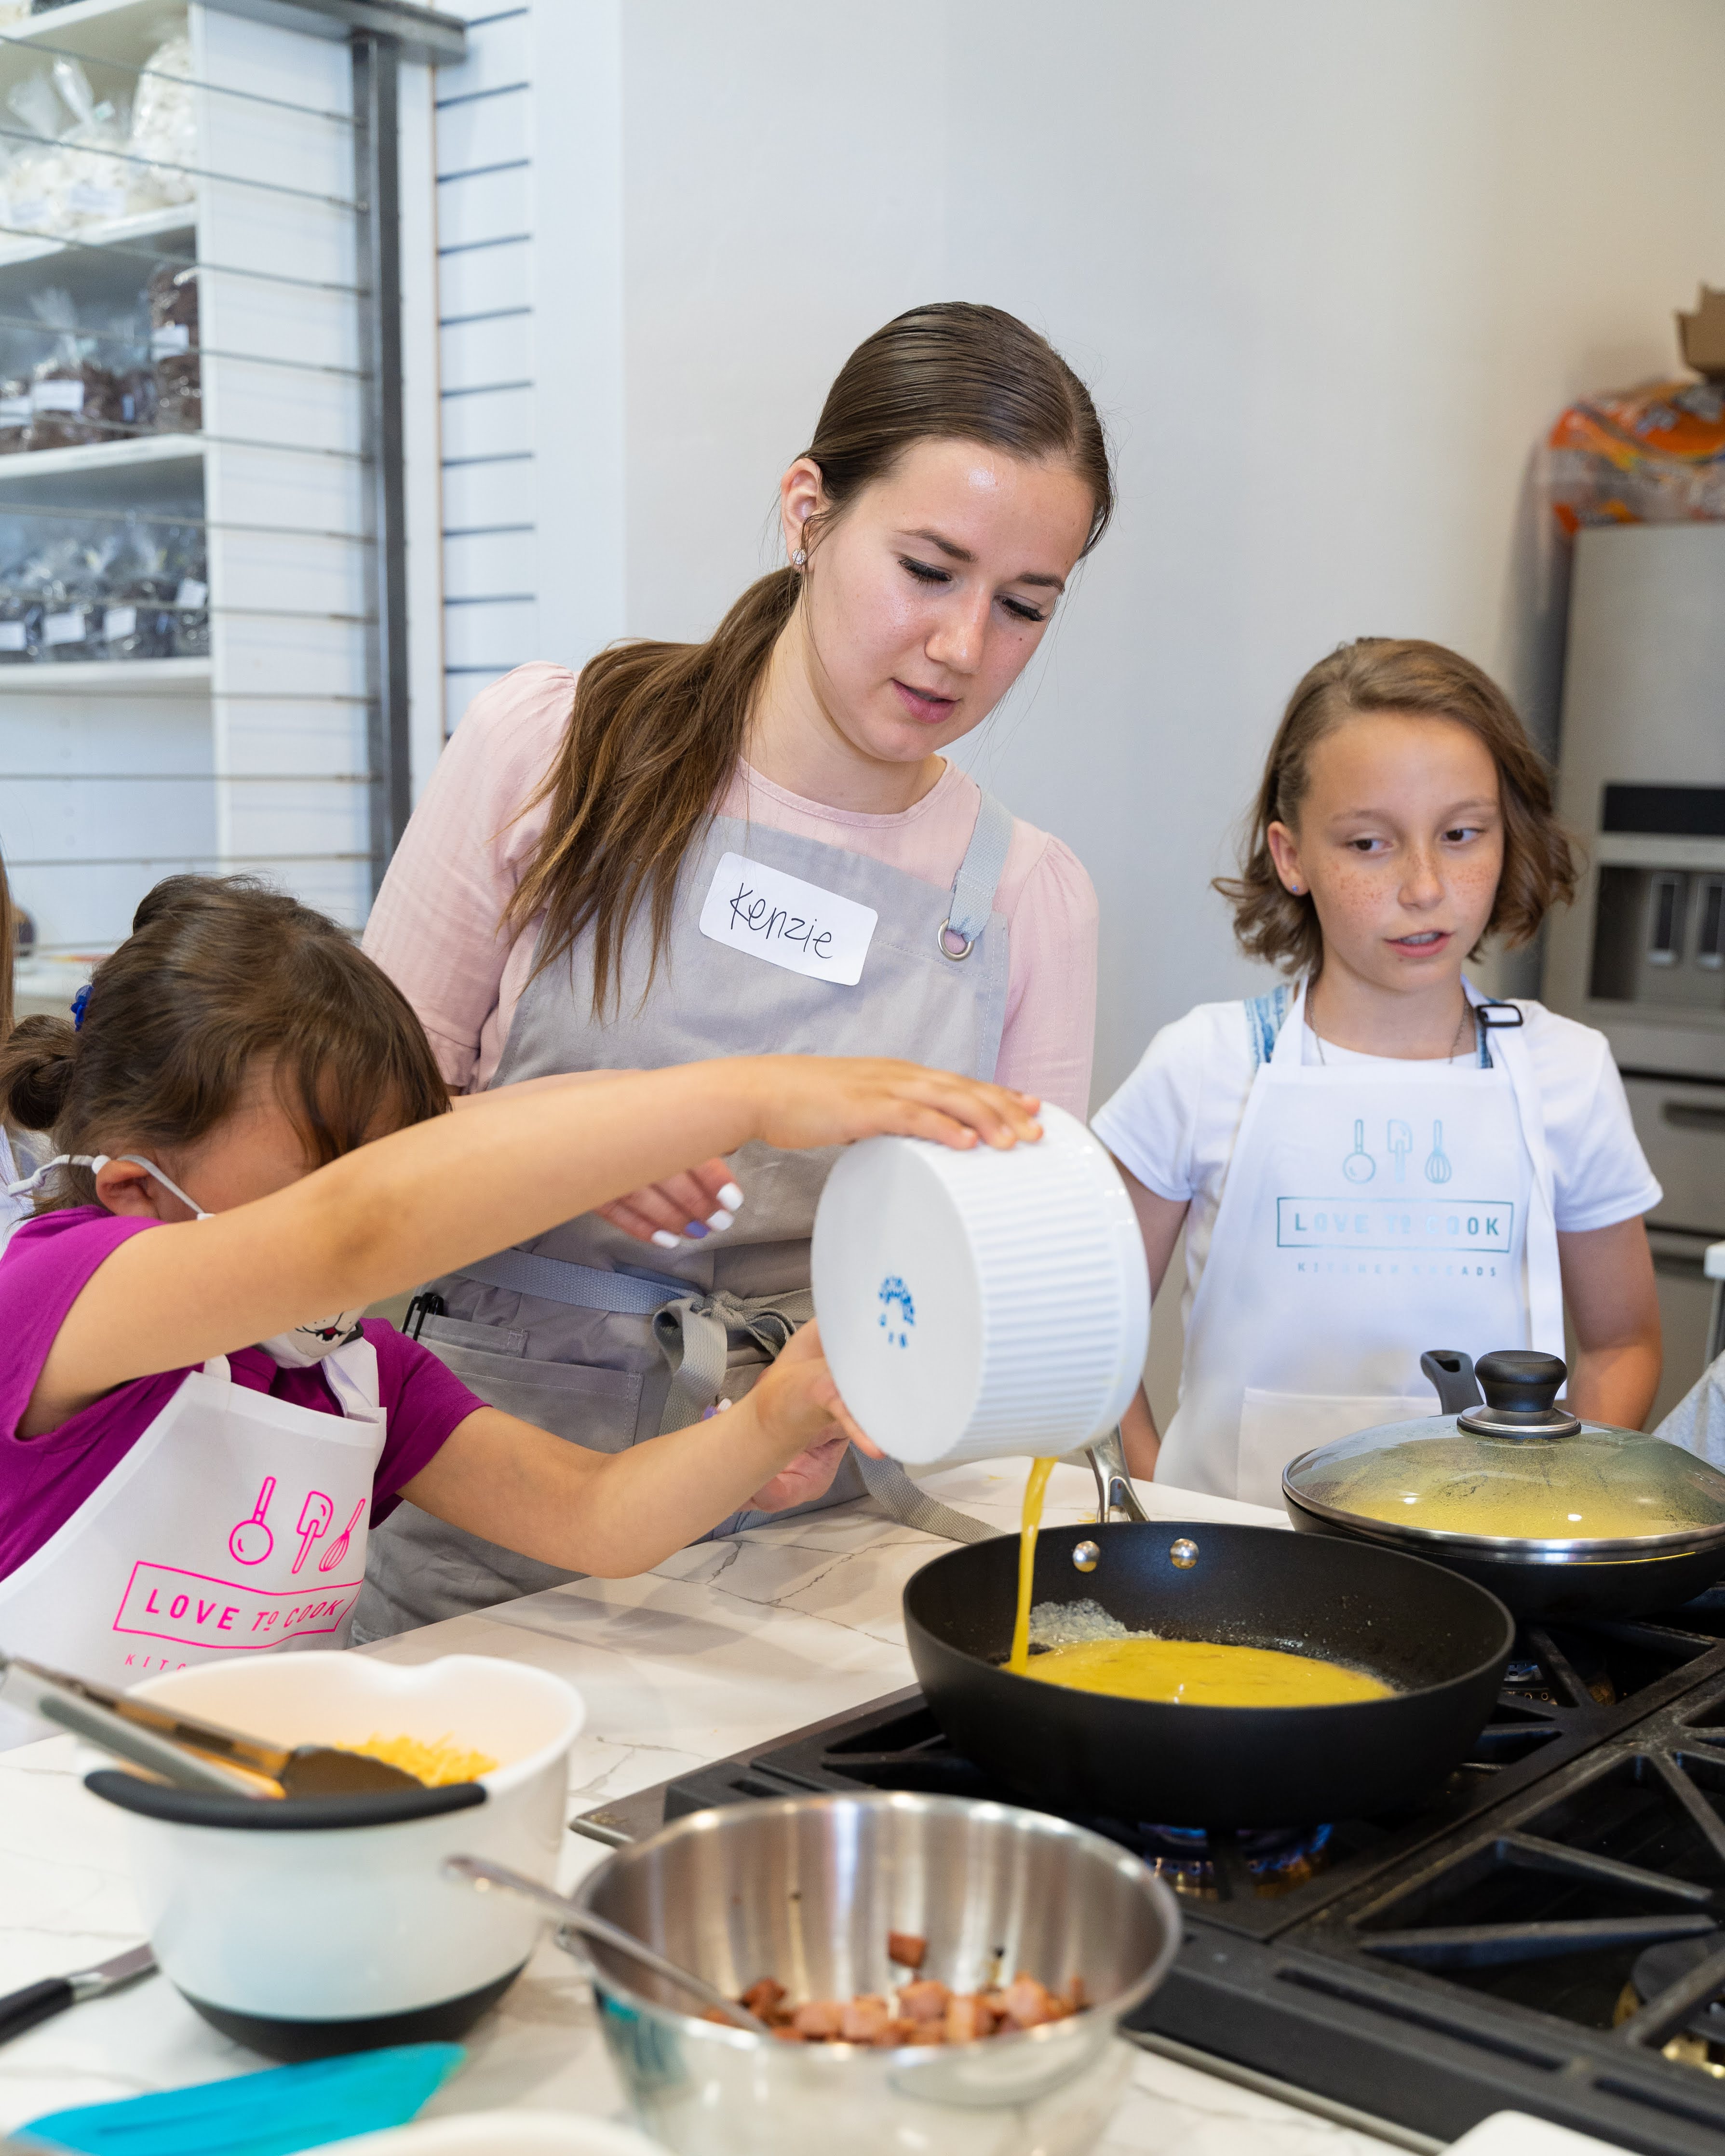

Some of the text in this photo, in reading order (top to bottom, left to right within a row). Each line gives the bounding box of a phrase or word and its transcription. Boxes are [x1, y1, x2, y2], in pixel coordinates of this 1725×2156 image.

[729, 882, 833, 958] Kenzie
[1295, 1213, 1369, 1234] LOVE
[1426, 1215, 1499, 1237] COOK
[145, 1589, 240, 1630] LOVE
[283, 1599, 345, 1628] COOK
[124, 1653, 187, 1671] KITC
